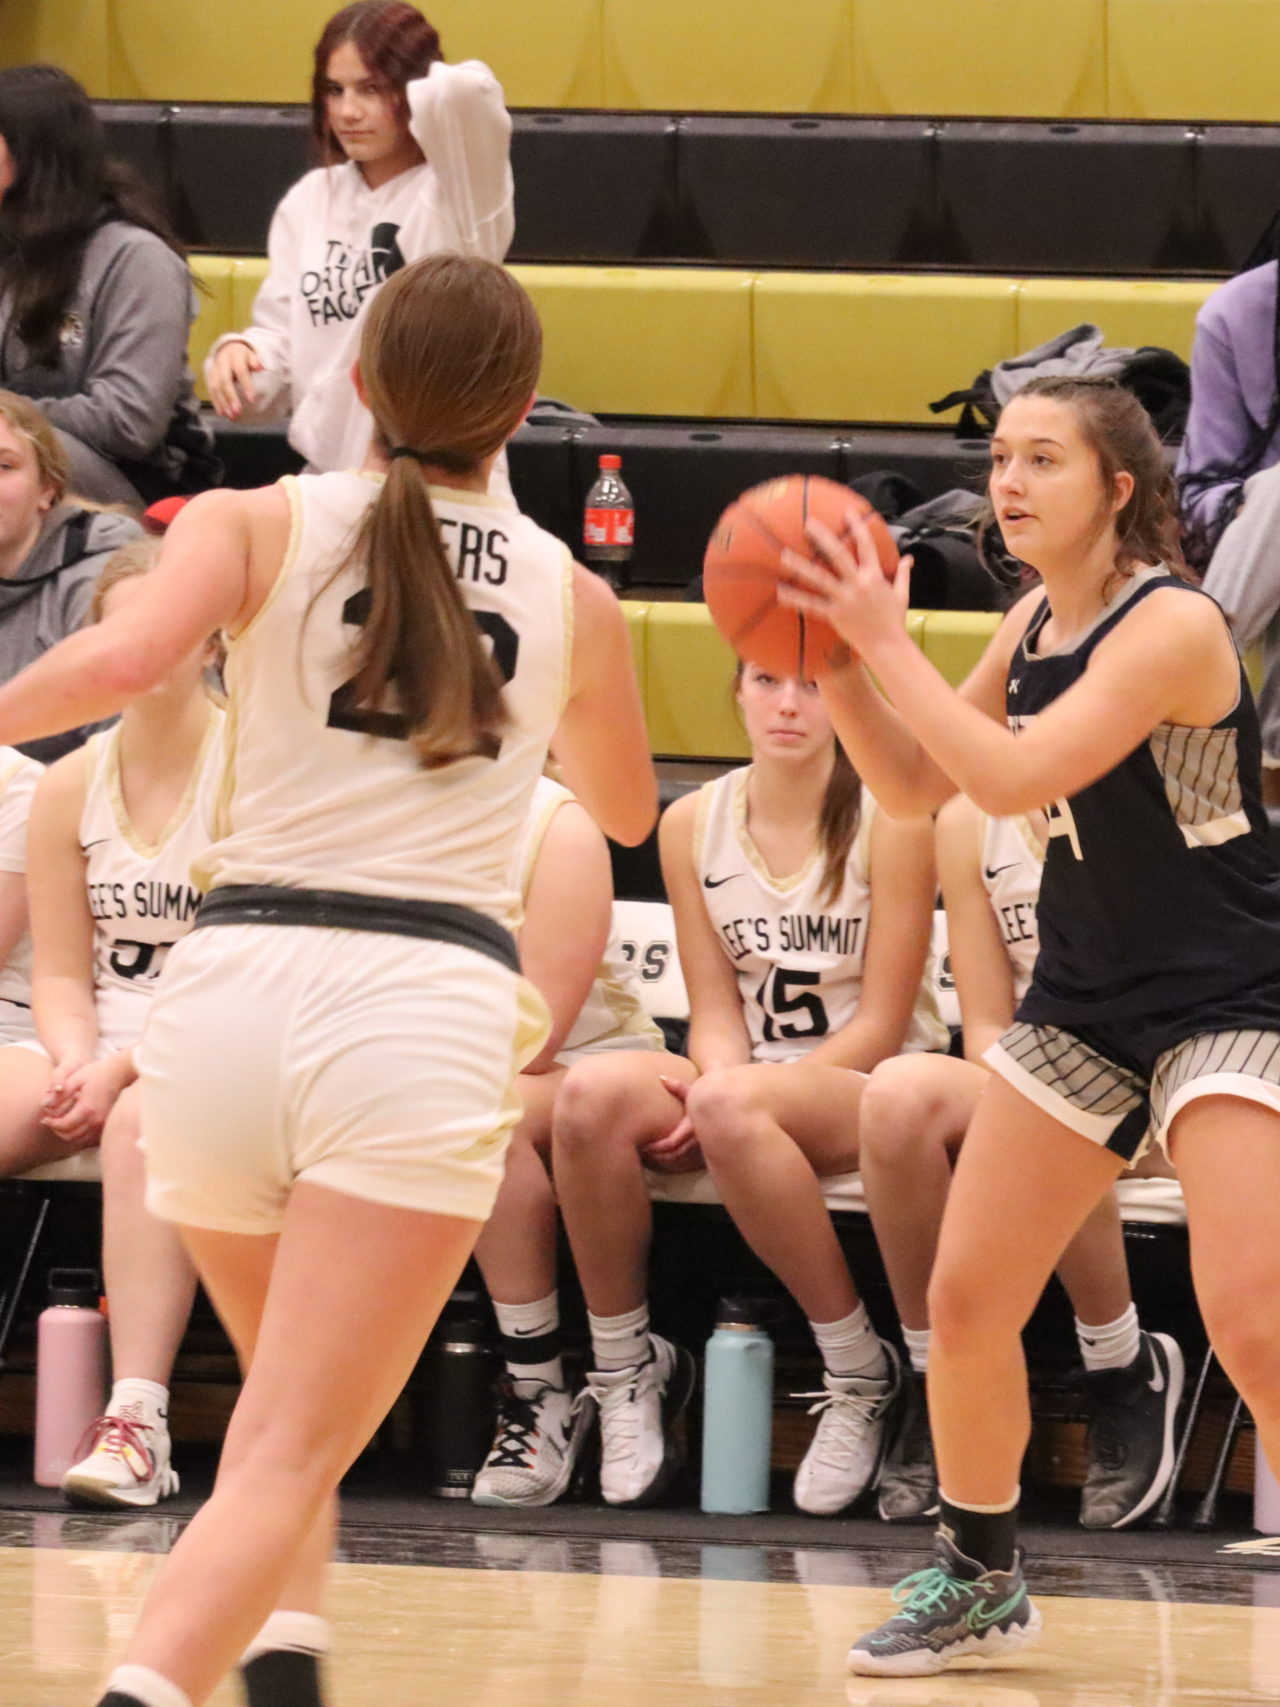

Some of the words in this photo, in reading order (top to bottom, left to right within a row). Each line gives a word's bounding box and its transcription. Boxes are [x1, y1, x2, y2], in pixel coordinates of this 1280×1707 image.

[134, 880, 203, 922] SUMM
[778, 914, 863, 955] SUMMIT
[755, 962, 830, 1042] 15
